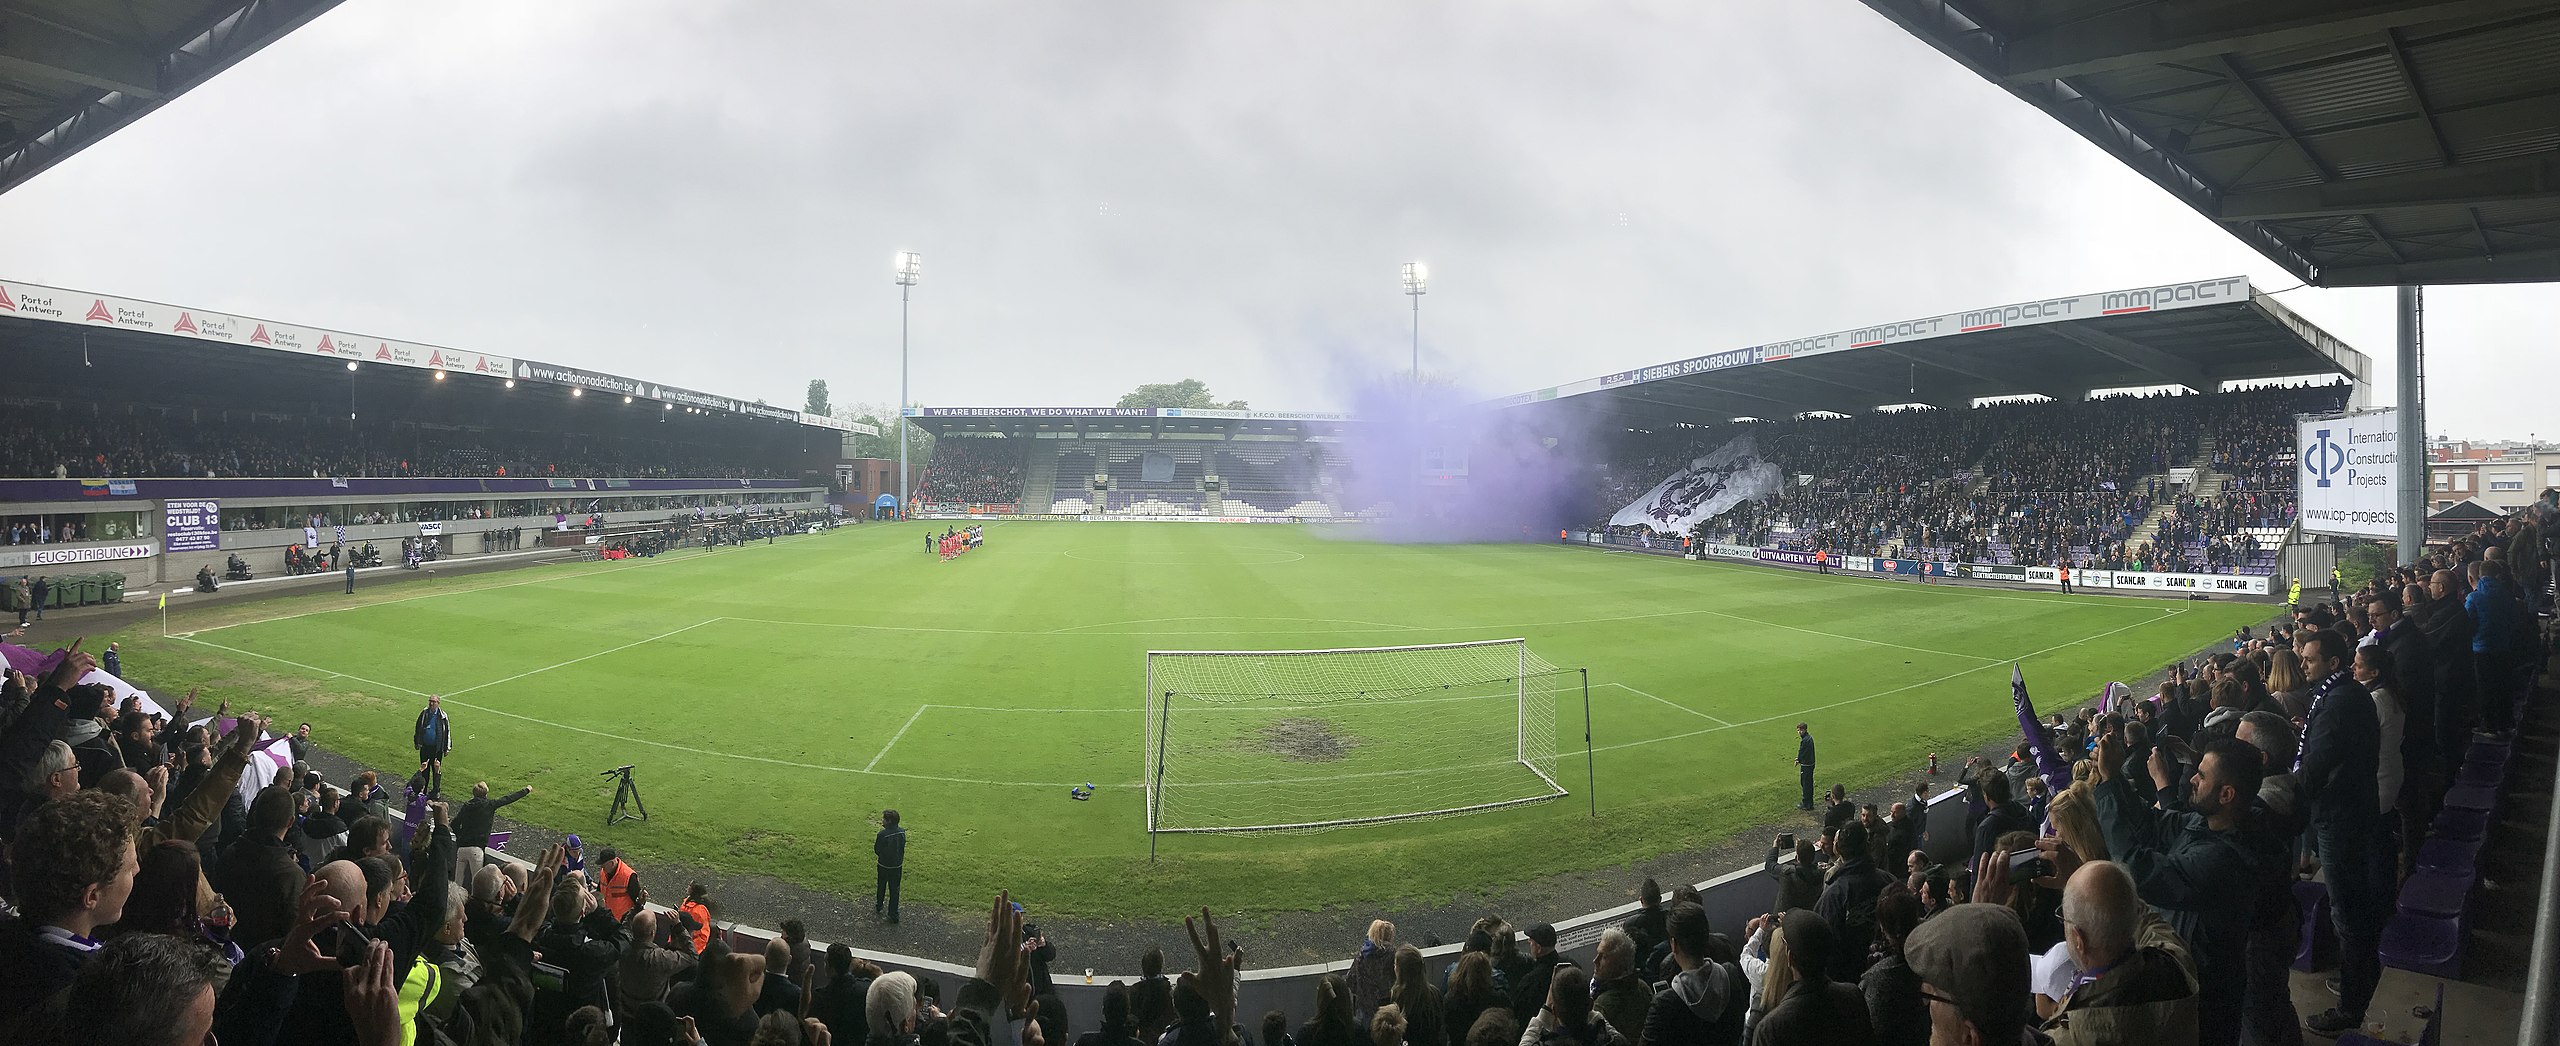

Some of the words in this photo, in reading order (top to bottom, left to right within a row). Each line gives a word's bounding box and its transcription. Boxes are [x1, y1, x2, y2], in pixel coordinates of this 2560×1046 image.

[21, 294, 41, 304] Port
[43, 298, 52, 306] of
[20, 303, 63, 317] Antwerp
[118, 308, 135, 317] Port
[117, 316, 154, 328] Antwerp
[201, 320, 217, 329] Port
[201, 328, 233, 339] Antwerp
[275, 331, 289, 340] Port
[274, 339, 302, 349] Antwerp
[338, 341, 350, 349] Port
[338, 348, 362, 357] Antwerp
[394, 348, 405, 356] Port
[394, 355, 416, 364] Antwerp
[445, 361, 465, 369] Antwerp
[1642, 363, 1680, 381] SIEBENS
[1683, 350, 1750, 373] SPOORBOUW
[490, 367, 507, 375] Antwerp
[533, 367, 634, 392] www.actiononaddiction.be
[933, 408, 948, 416] WE
[950, 408, 969, 416] ARE
[971, 408, 1028, 417] BEERSCHOT,
[1031, 408, 1046, 416] WE
[1048, 408, 1062, 416] DO
[1065, 408, 1094, 416] WHAT
[1096, 408, 1112, 416] WE
[1115, 408, 1148, 416] WANT!
[2347, 448, 2397, 465] Constructi
[2347, 468, 2387, 488] Projects
[167, 515, 200, 527] CLUB
[205, 515, 218, 525] 13
[32, 547, 129, 563] JEUGDTRIBUNE
[1761, 551, 1804, 563] UITVAARTEN
[2029, 571, 2054, 580] SCANCAR
[2117, 576, 2146, 586] SCANCAR
[2217, 579, 2247, 590] SCANCAR
